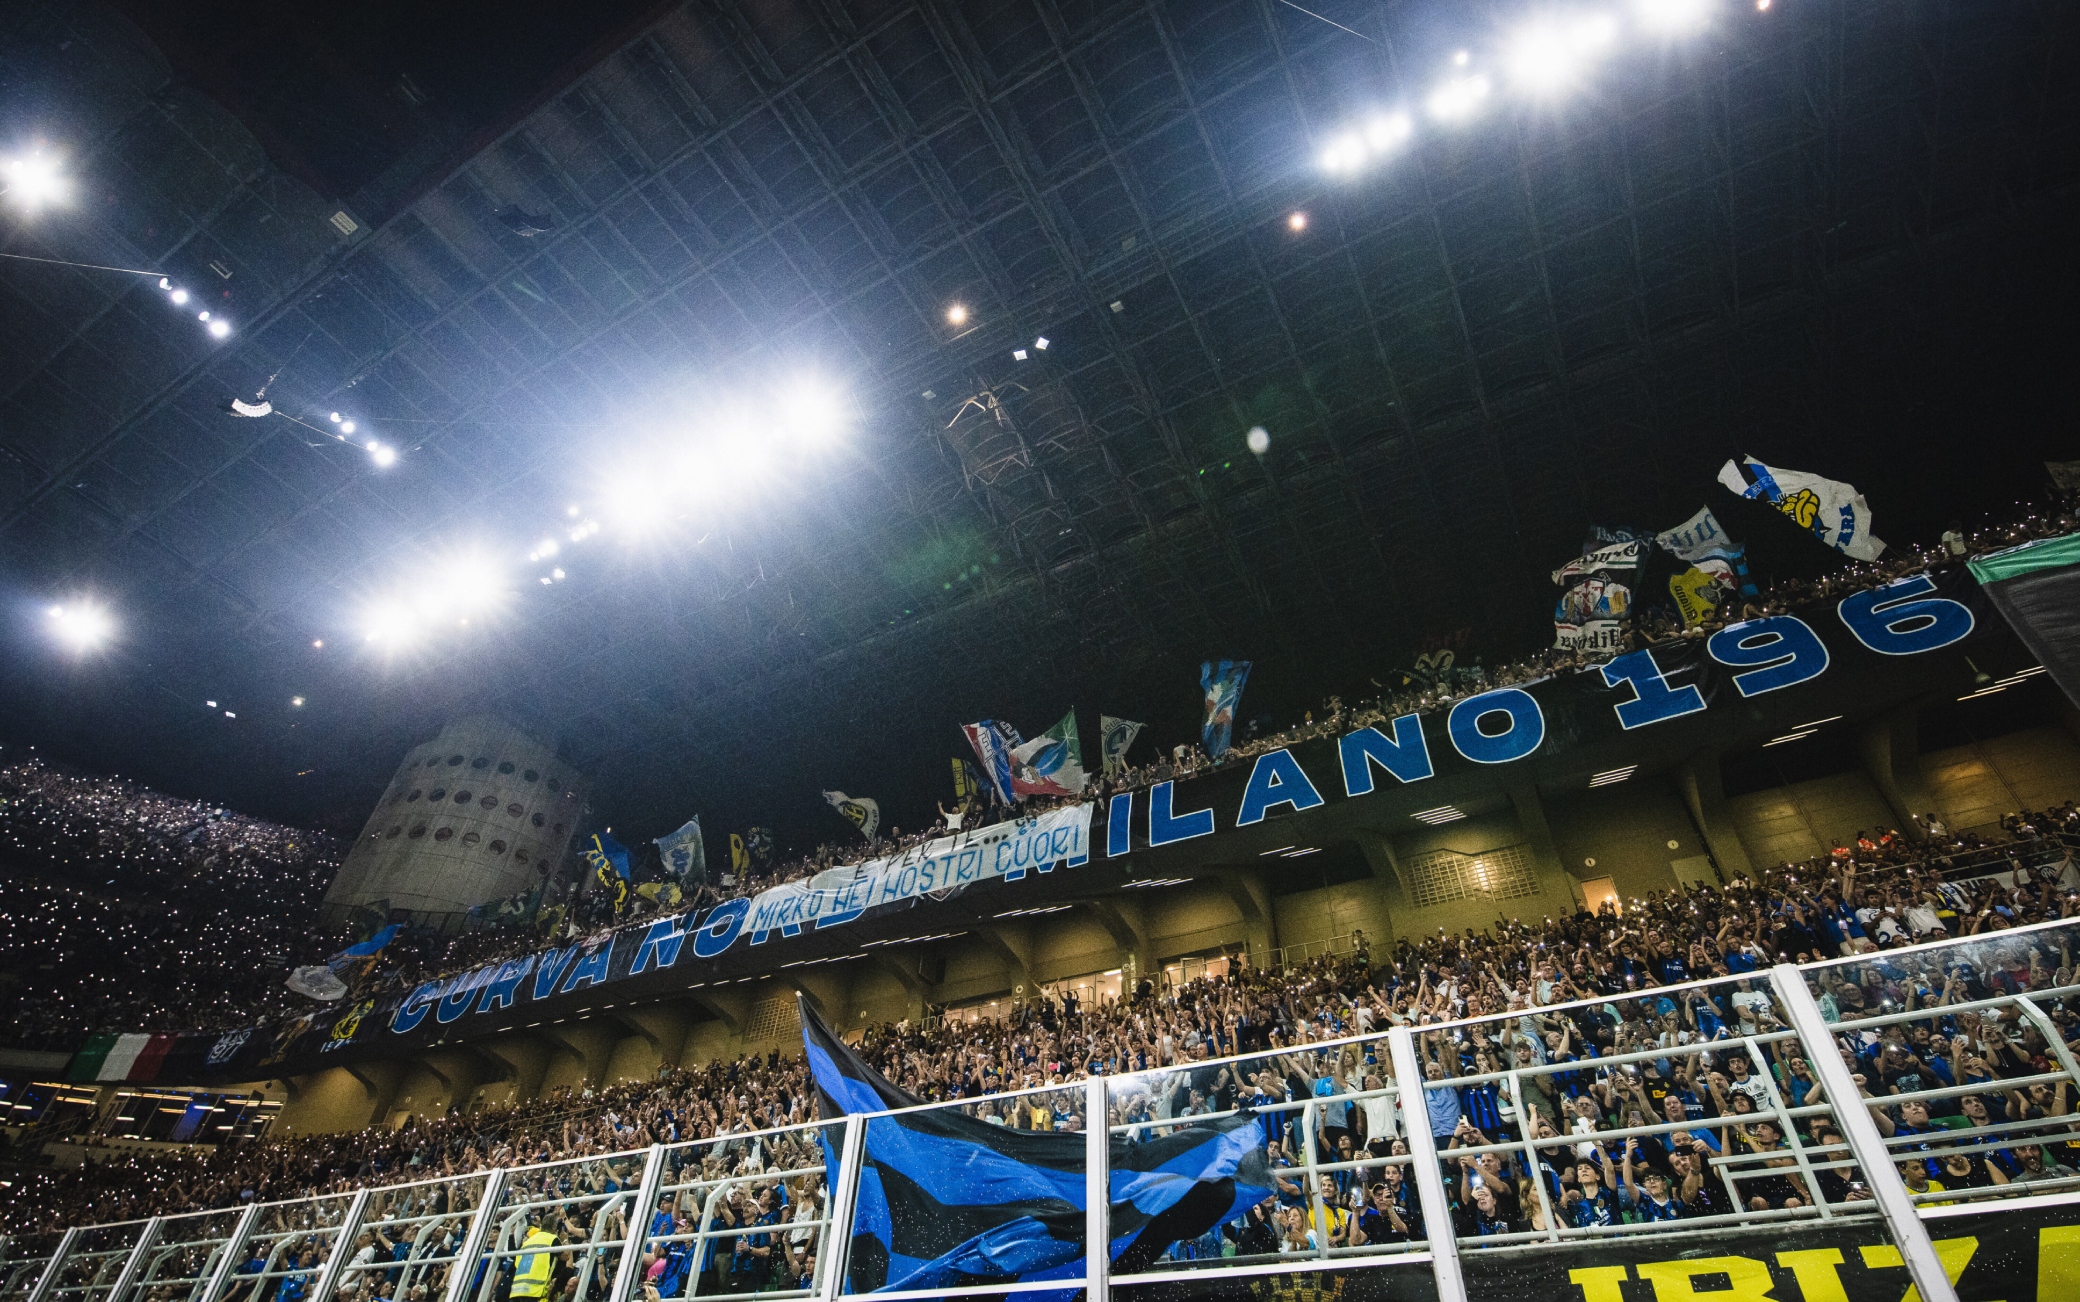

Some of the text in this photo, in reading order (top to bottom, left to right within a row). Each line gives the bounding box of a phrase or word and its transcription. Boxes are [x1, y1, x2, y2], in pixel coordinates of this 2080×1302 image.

[391, 575, 1975, 1034] CURVA NO ILANO 196
[751, 889, 825, 930] MIRKO
[995, 824, 1079, 873] CUORI
